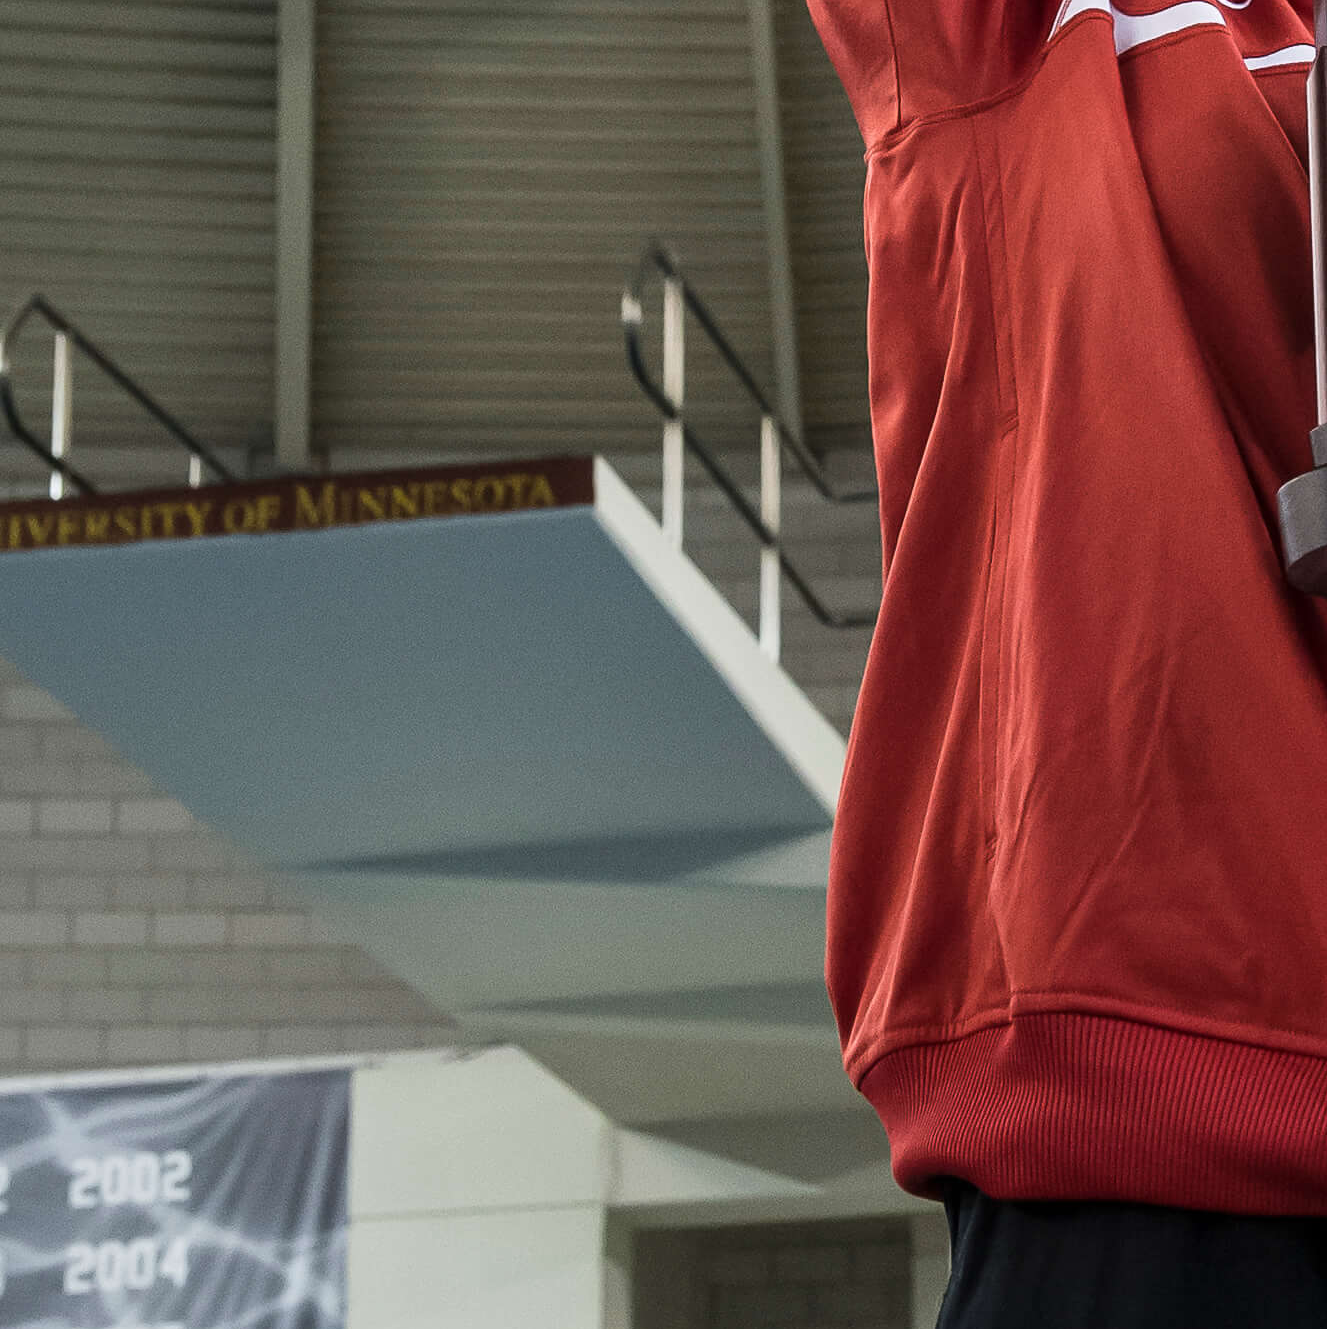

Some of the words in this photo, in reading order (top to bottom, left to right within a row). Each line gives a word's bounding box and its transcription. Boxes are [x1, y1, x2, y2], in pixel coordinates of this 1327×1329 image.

[7, 502, 212, 549] IVERSITY
[224, 496, 280, 534] OF
[68, 1151, 192, 1209] 2002
[63, 1234, 190, 1295] 2004
